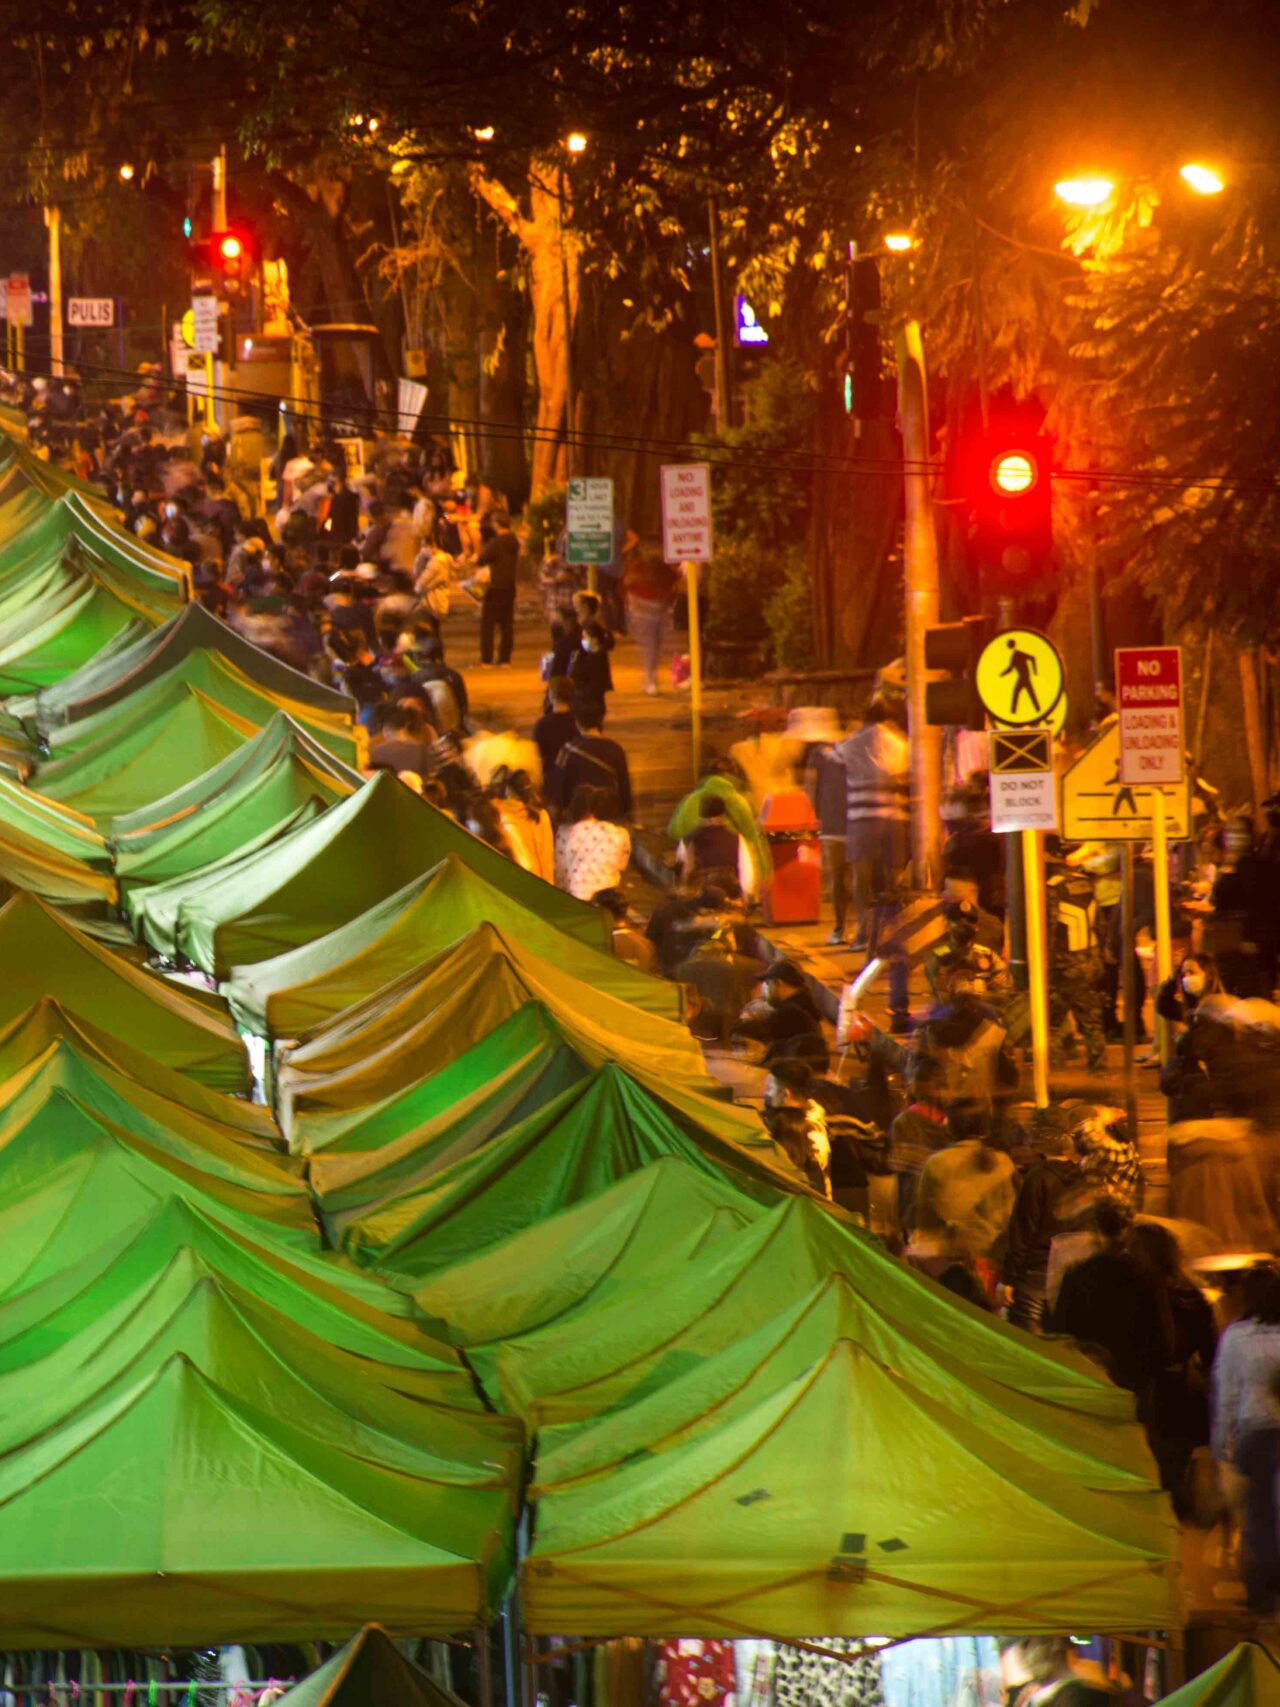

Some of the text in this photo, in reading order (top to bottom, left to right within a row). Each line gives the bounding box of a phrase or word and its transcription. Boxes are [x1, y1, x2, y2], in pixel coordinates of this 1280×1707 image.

[71, 302, 110, 321] PULIS
[677, 471, 694, 482] NO
[570, 480, 586, 501] 3
[670, 487, 703, 498] LOADING
[679, 502, 695, 513] AND
[1137, 660, 1161, 676] NO
[1122, 684, 1178, 701] PARKING
[1124, 714, 1167, 730] LOADING
[1125, 735, 1179, 749] UNLOADING
[1139, 755, 1164, 770] ONLY
[1000, 779, 1044, 791] DO NOT
[1005, 797, 1041, 807] BLOCK
